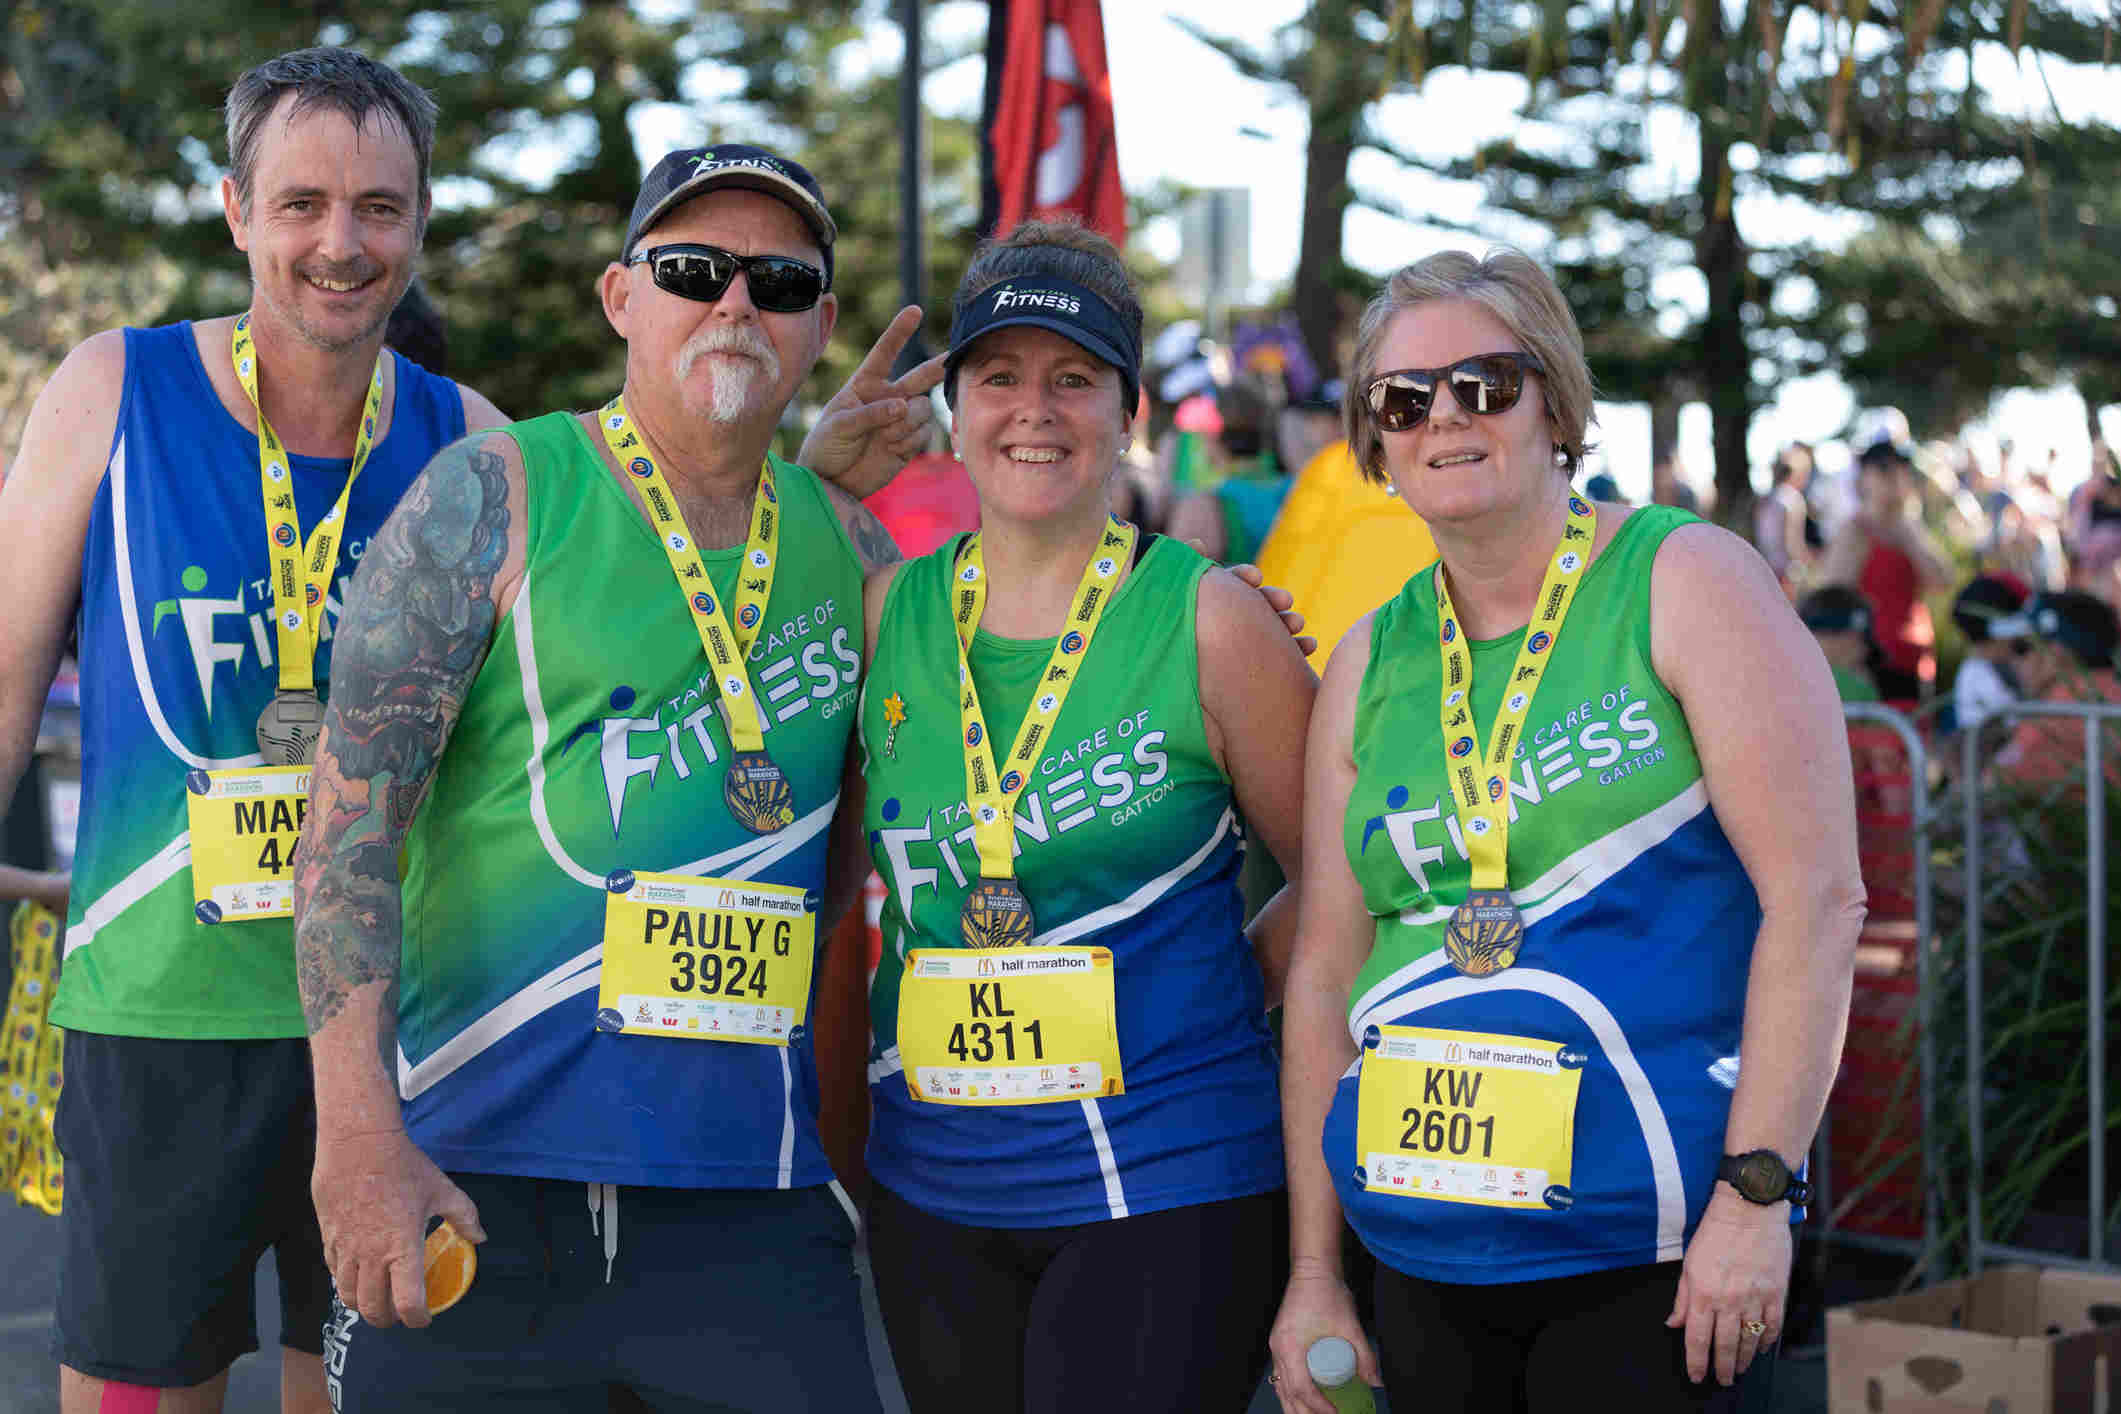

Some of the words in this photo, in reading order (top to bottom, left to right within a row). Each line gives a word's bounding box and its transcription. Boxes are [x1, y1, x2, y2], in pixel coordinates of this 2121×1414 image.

[992, 290, 1081, 314] FITNESS
[750, 615, 811, 663] CARE
[814, 599, 838, 625] OF
[822, 688, 858, 720] GATTO
[1534, 701, 1593, 742] CARE
[1601, 685, 1632, 711] OF
[1040, 727, 1109, 776] CARE
[1117, 709, 1150, 738] OF
[1598, 747, 1666, 787] GATTON
[1110, 779, 1176, 827] GATTON
[1383, 699, 1660, 895] FINESS
[741, 894, 761, 907] half
[762, 897, 801, 912] marathon
[644, 908, 766, 954] PAULY
[773, 920, 792, 957] G
[670, 951, 768, 999] 3924
[1001, 961, 1024, 971] half
[1027, 957, 1086, 970] marathon
[969, 982, 1015, 1018] KL
[948, 1019, 1044, 1062] 4311
[1468, 1047, 1492, 1062] half
[1496, 1050, 1553, 1069] marathon
[1423, 1067, 1483, 1109] KW
[1399, 1107, 1496, 1159] 2601
